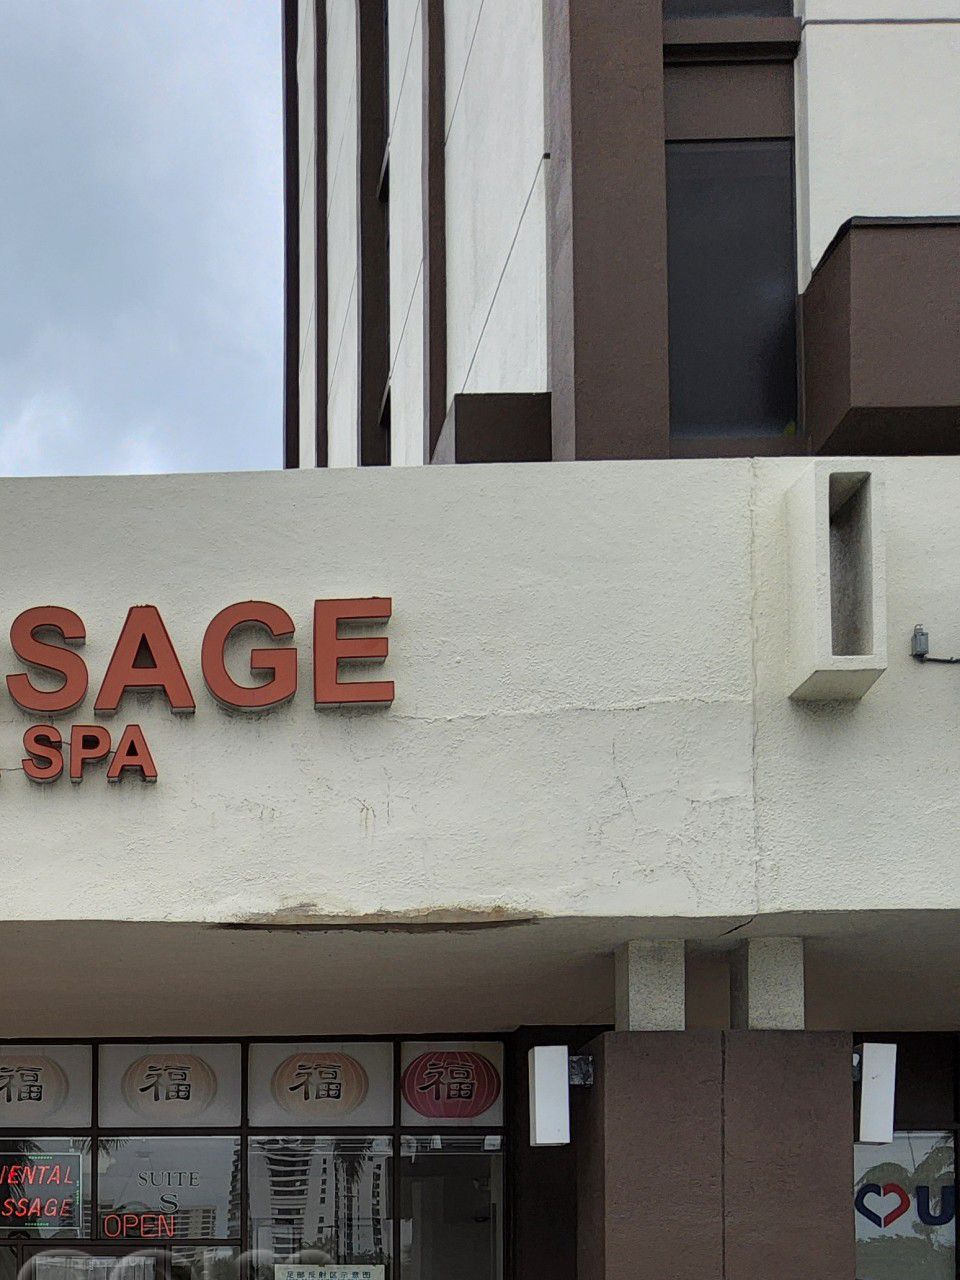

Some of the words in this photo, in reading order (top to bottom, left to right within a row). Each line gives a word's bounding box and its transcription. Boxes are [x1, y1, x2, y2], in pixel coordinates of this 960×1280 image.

[22, 724, 158, 782] SPA
[139, 1064, 193, 1102] 福
[287, 1062, 343, 1102] 福
[417, 1061, 478, 1101] 福
[138, 1171, 200, 1188] SUITE
[159, 1193, 180, 1214] S
[103, 1214, 176, 1238] OPEN
